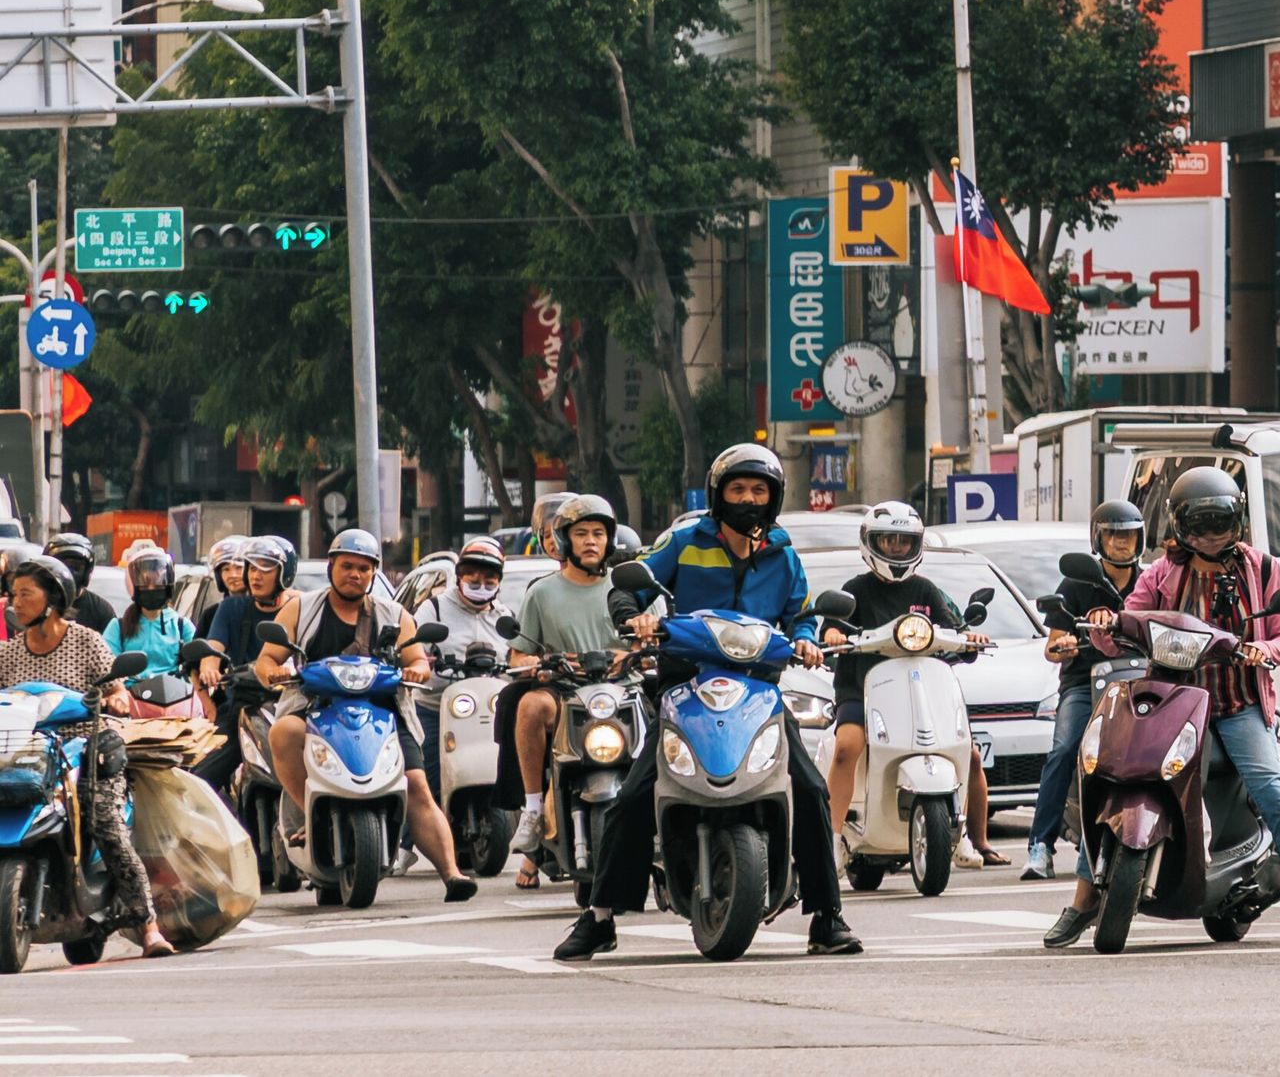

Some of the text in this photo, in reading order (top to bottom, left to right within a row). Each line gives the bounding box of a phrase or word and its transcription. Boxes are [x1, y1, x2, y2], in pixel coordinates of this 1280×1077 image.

[85, 213, 172, 229] 北平路
[848, 175, 894, 232] P
[789, 251, 824, 367] 屈臣氏
[955, 481, 995, 523] P
